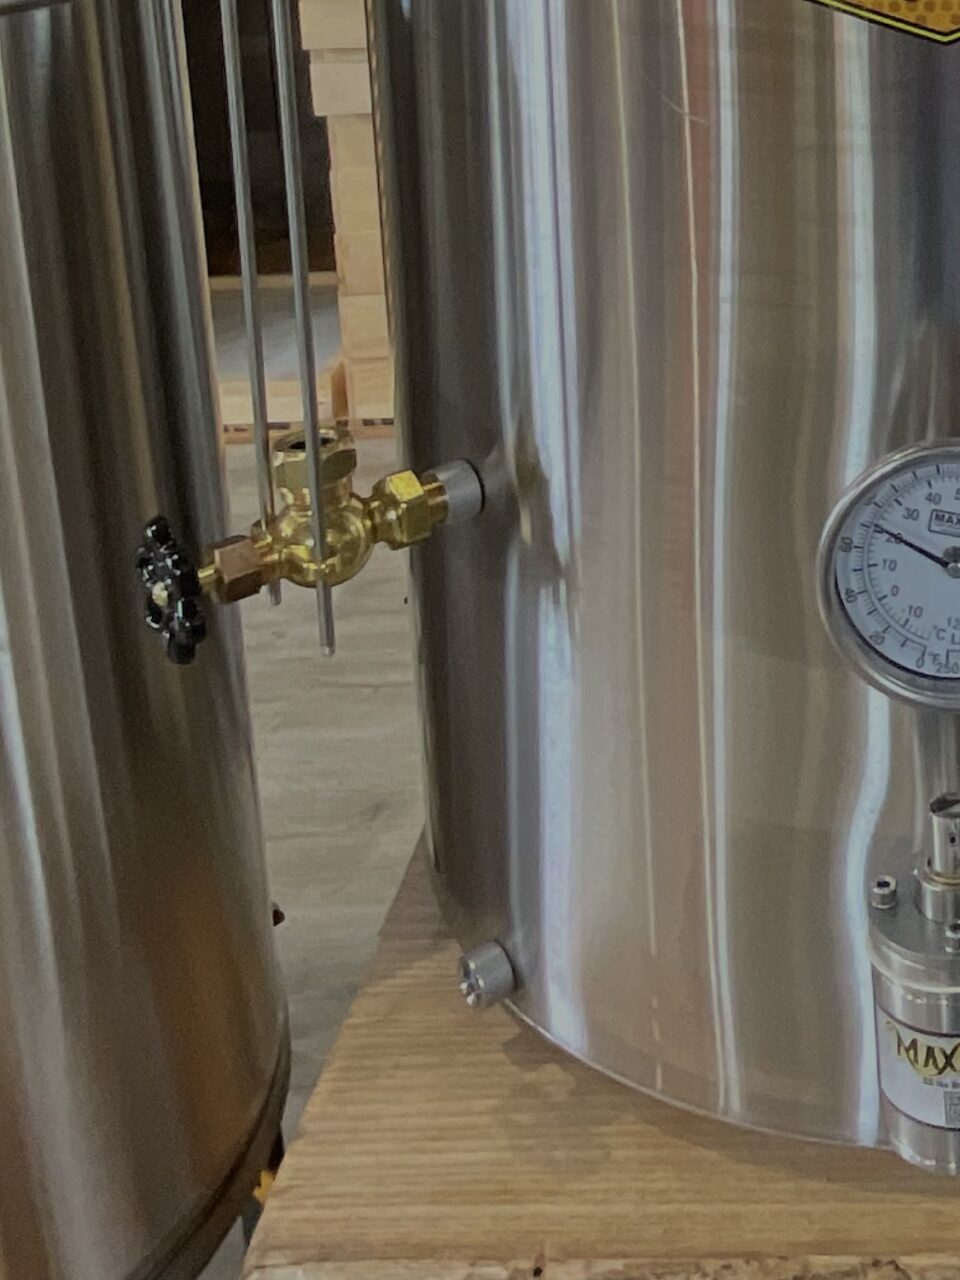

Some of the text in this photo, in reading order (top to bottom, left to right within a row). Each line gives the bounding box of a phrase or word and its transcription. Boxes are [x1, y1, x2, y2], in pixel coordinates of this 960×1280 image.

[925, 491, 942, 505] 40
[902, 506, 920, 521] 30
[882, 558, 898, 572] 10
